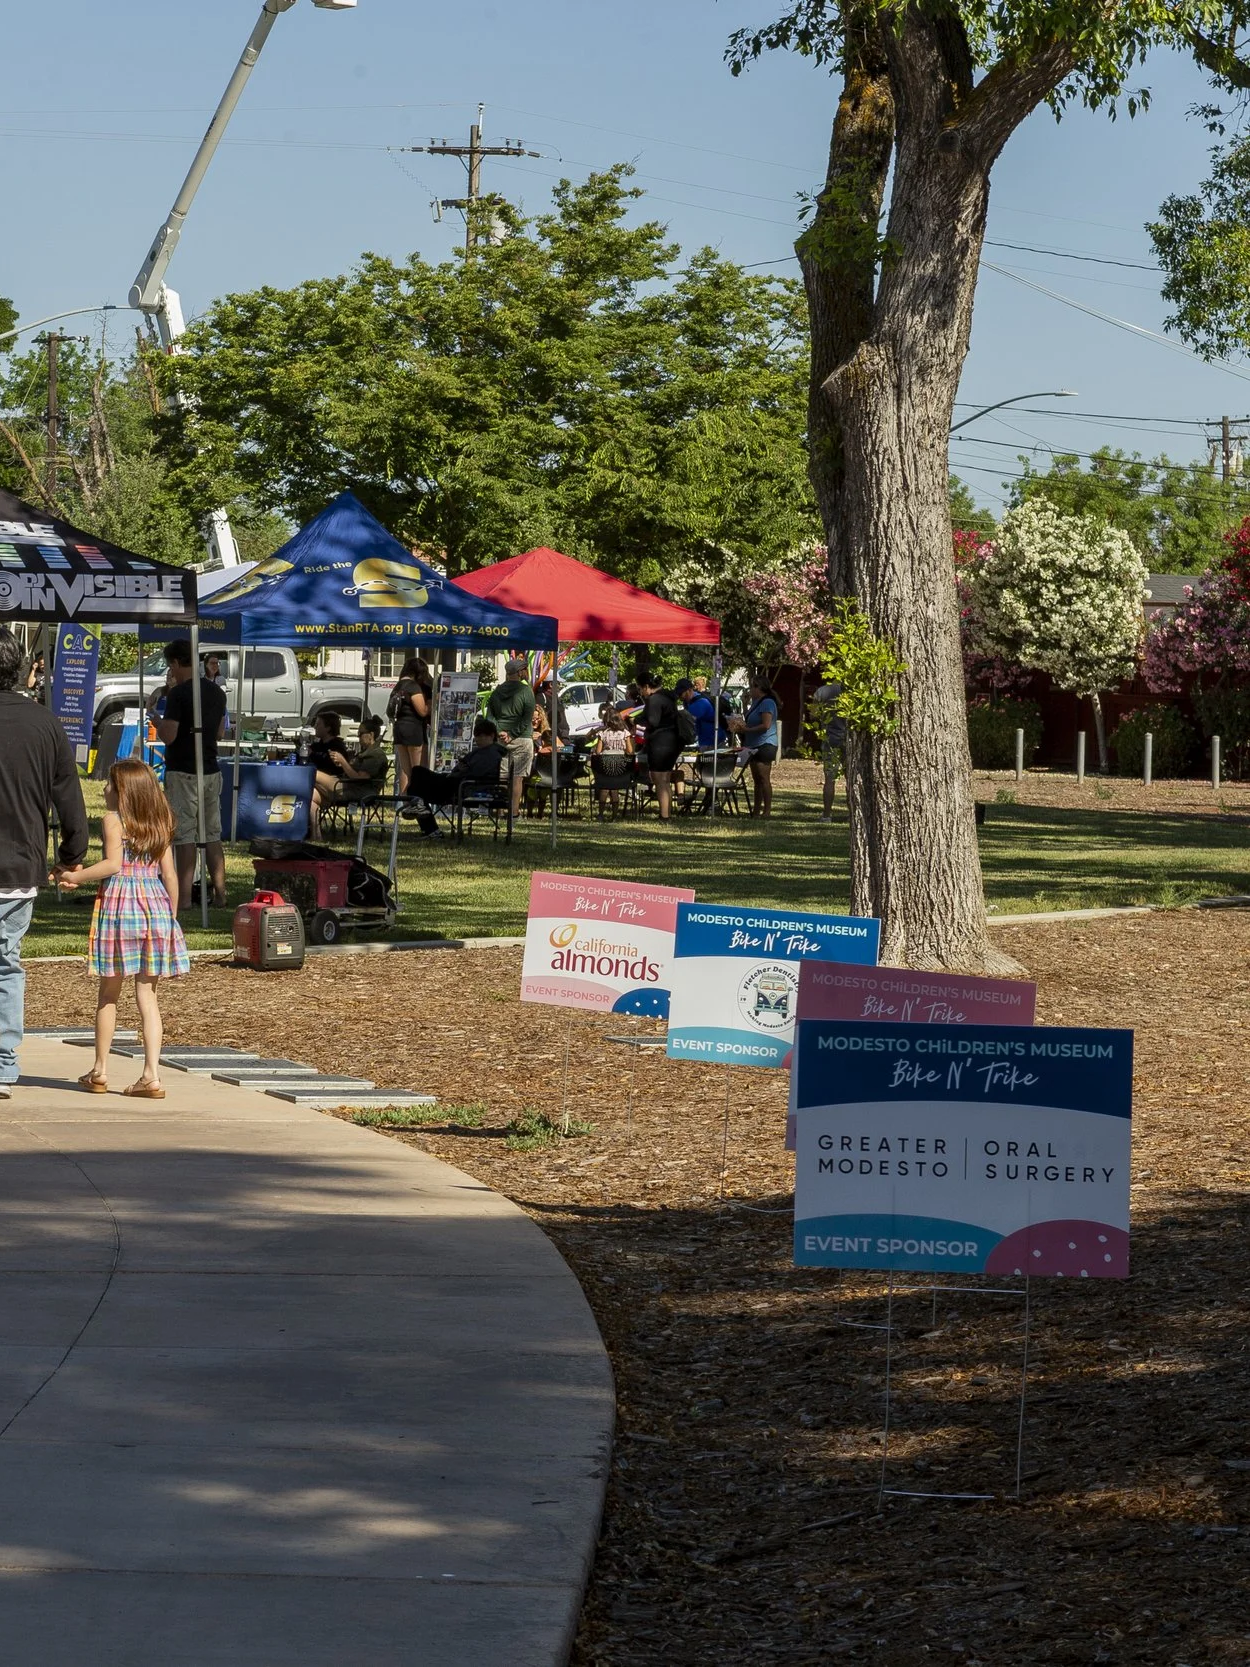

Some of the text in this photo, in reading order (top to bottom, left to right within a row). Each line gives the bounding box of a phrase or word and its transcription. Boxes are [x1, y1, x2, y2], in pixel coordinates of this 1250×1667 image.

[303, 560, 352, 574] Ride the
[294, 622, 510, 637] www.StanRTA.org (209) 527-4900
[63, 633, 93, 650] CAC
[58, 716, 84, 724] XPERIENCE
[540, 881, 586, 894] MODESTO
[643, 894, 684, 905] MUSEUM
[573, 896, 599, 912] Bike
[616, 902, 647, 918] Trike
[687, 913, 744, 926] MODESTO
[816, 924, 868, 938] MUSEUM
[575, 938, 638, 957] california
[729, 929, 762, 949] Bike
[782, 934, 821, 955] Trike
[551, 949, 659, 982] almonds
[743, 966, 771, 990] Fletcher
[525, 984, 610, 1004] EVENT SPONSOR
[812, 973, 877, 990] MODESTO
[962, 989, 1022, 1006] MUSEUM
[860, 994, 899, 1017] Bike
[923, 1001, 968, 1023] Trike
[672, 1038, 778, 1058] EVENT SPONSOR
[817, 1036, 910, 1053] MODESTO
[1030, 1044, 1114, 1060] MUSEUM
[888, 1059, 942, 1089] Bike
[976, 1061, 1040, 1094] Trike
[818, 1134, 947, 1155] GREATER
[983, 1140, 1058, 1159] ORAL
[818, 1158, 948, 1178] MODESTO
[985, 1163, 1115, 1183] SURGERY
[804, 1235, 978, 1257] EVENT SPONSOR
